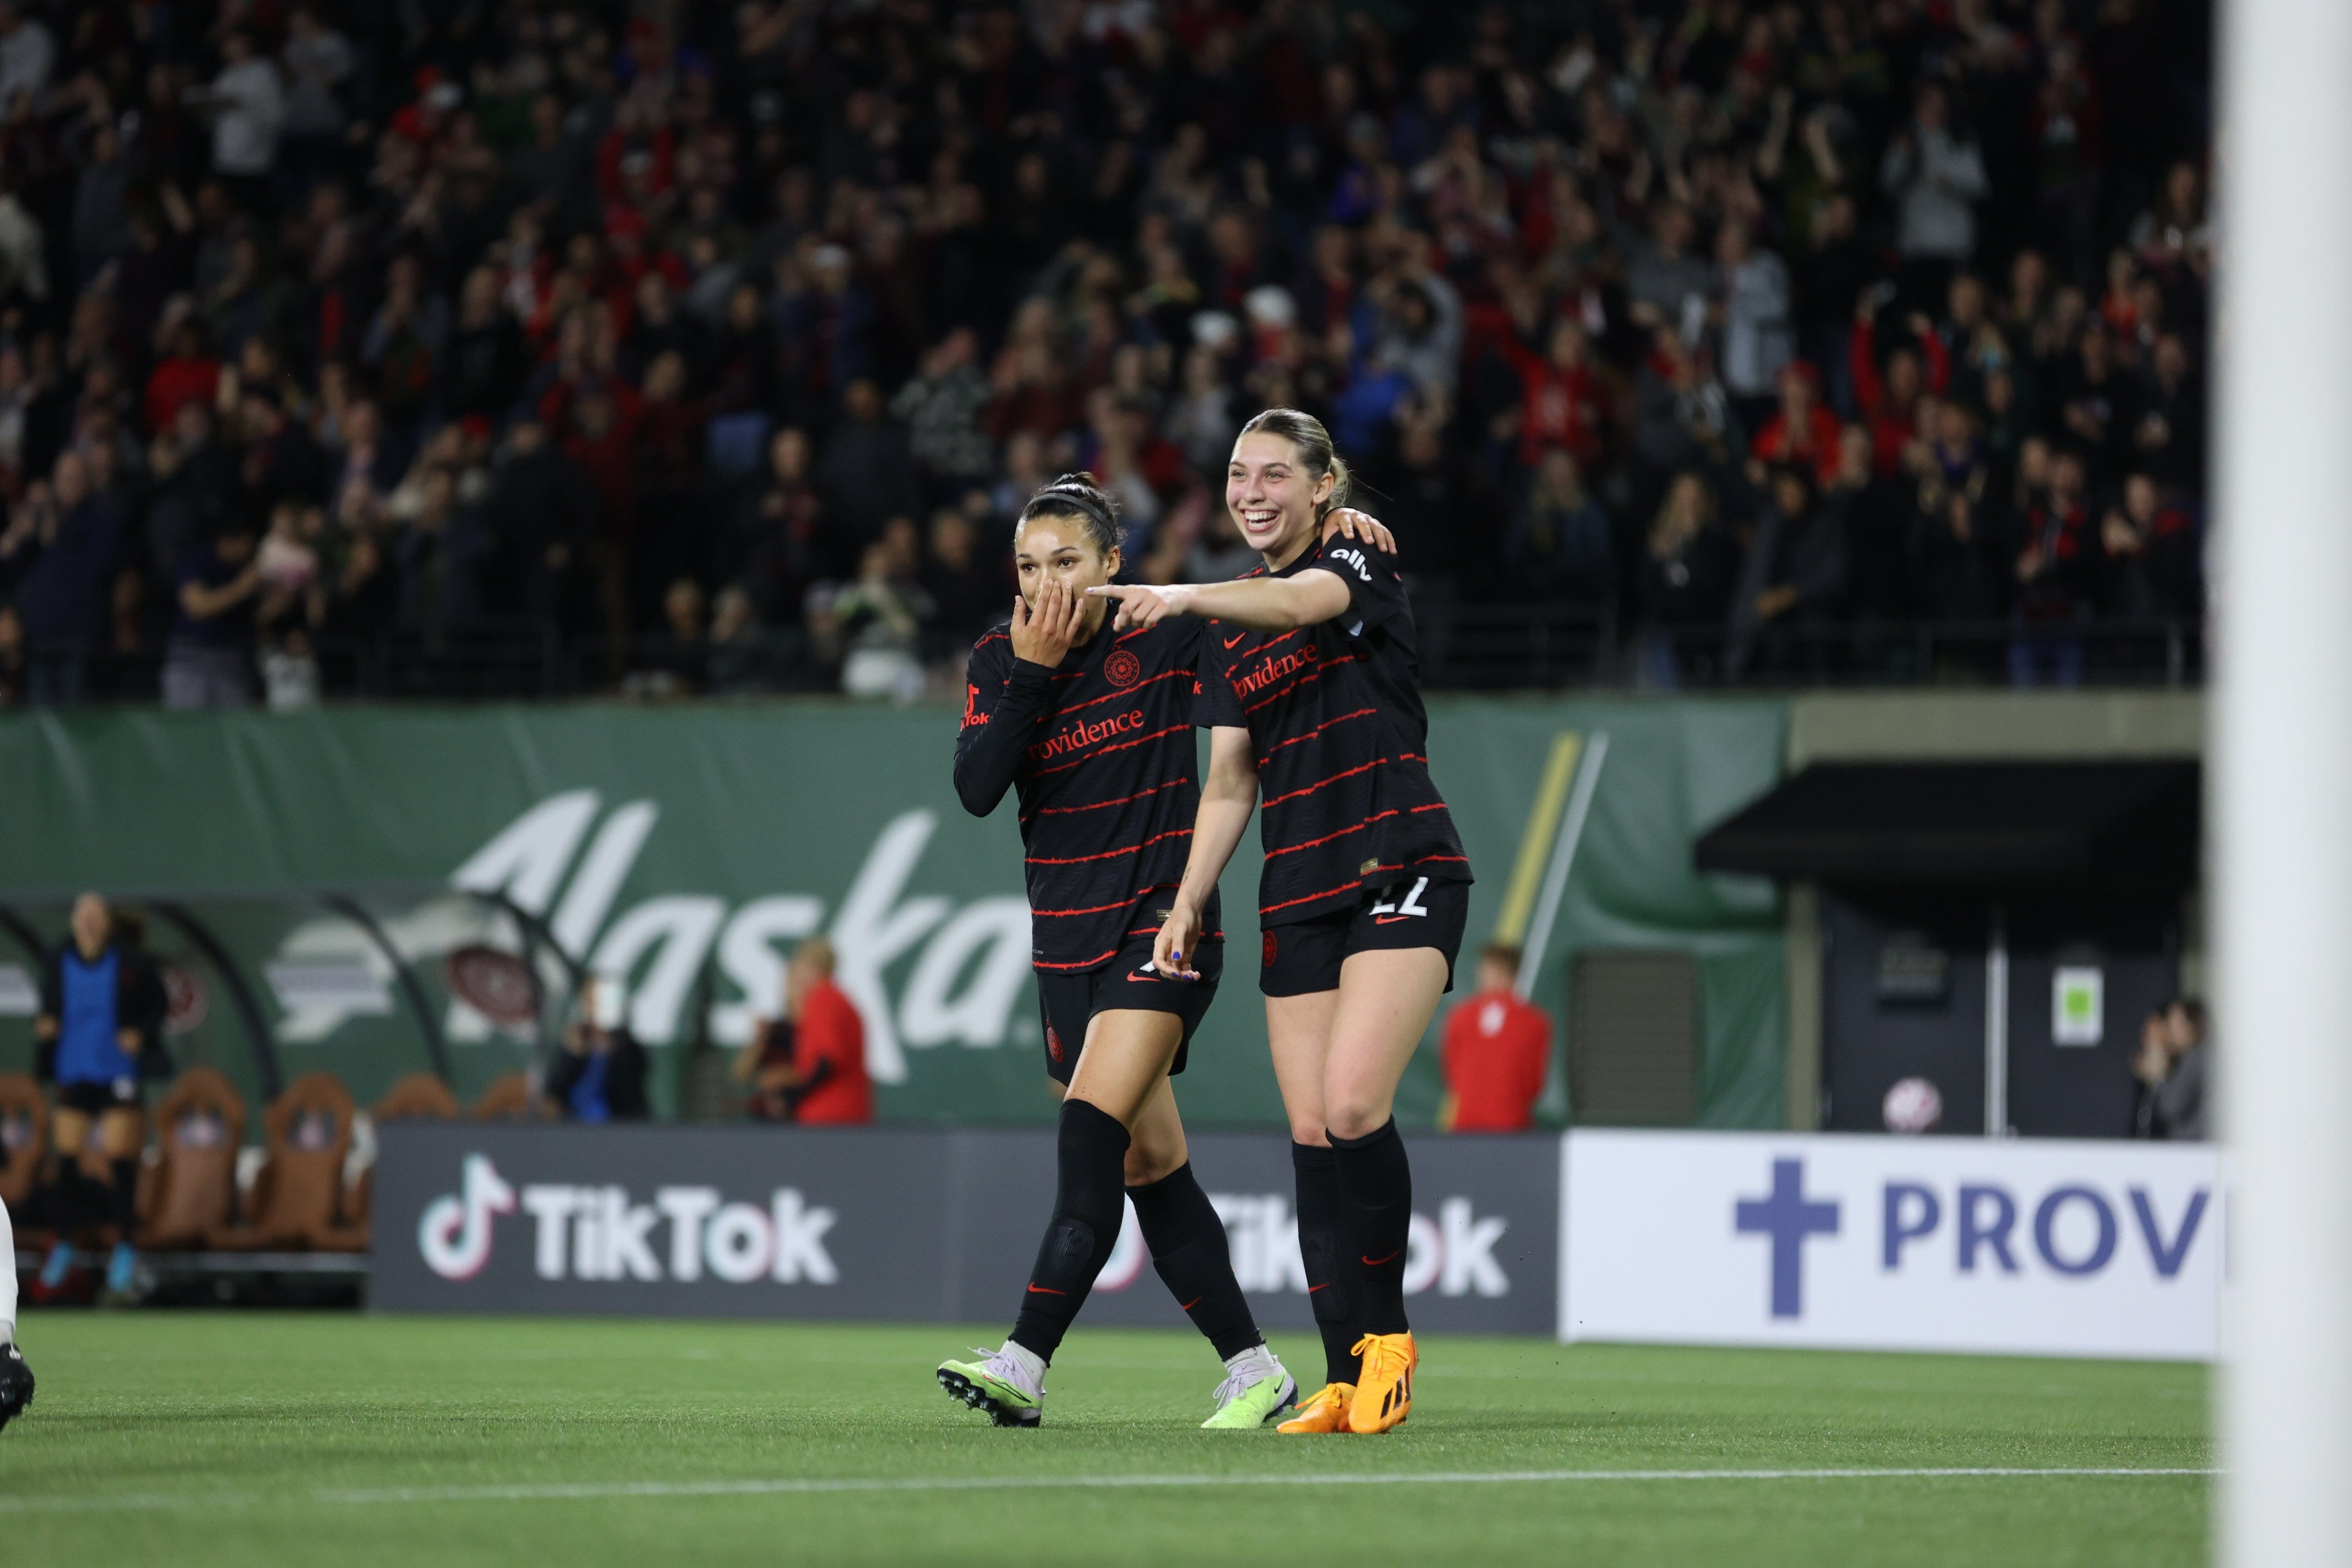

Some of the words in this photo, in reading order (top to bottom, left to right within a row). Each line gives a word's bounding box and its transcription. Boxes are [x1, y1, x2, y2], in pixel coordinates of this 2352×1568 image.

[1330, 548, 1372, 582] ally
[1233, 644, 1318, 700] rovidence
[1028, 710, 1144, 761] rovidence
[276, 788, 1032, 1084] Alaska
[521, 1183, 838, 1285] TikTok
[1881, 1178, 2234, 1285] PROV
